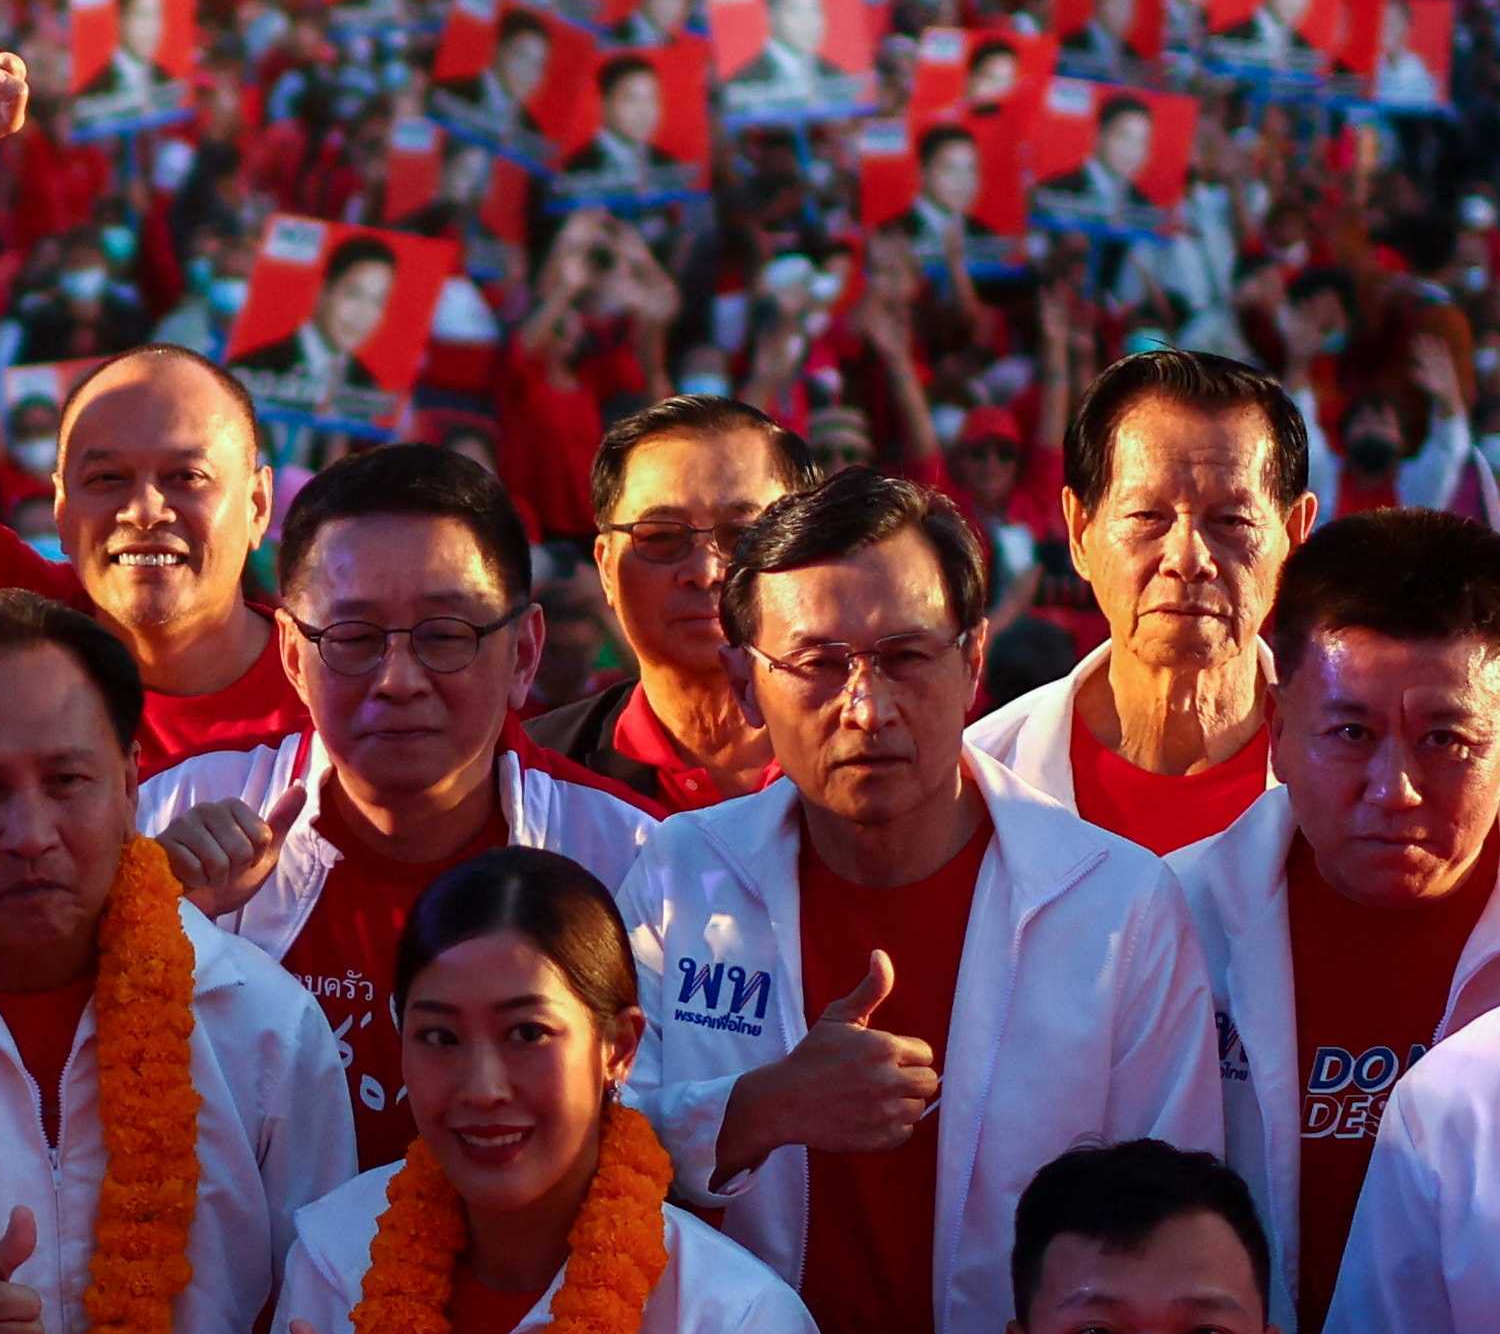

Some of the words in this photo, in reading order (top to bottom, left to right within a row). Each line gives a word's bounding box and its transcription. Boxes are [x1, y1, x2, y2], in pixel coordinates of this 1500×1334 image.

[678, 957, 771, 1019] พท
[674, 1008, 762, 1037] พรรคเพื่อไทย
